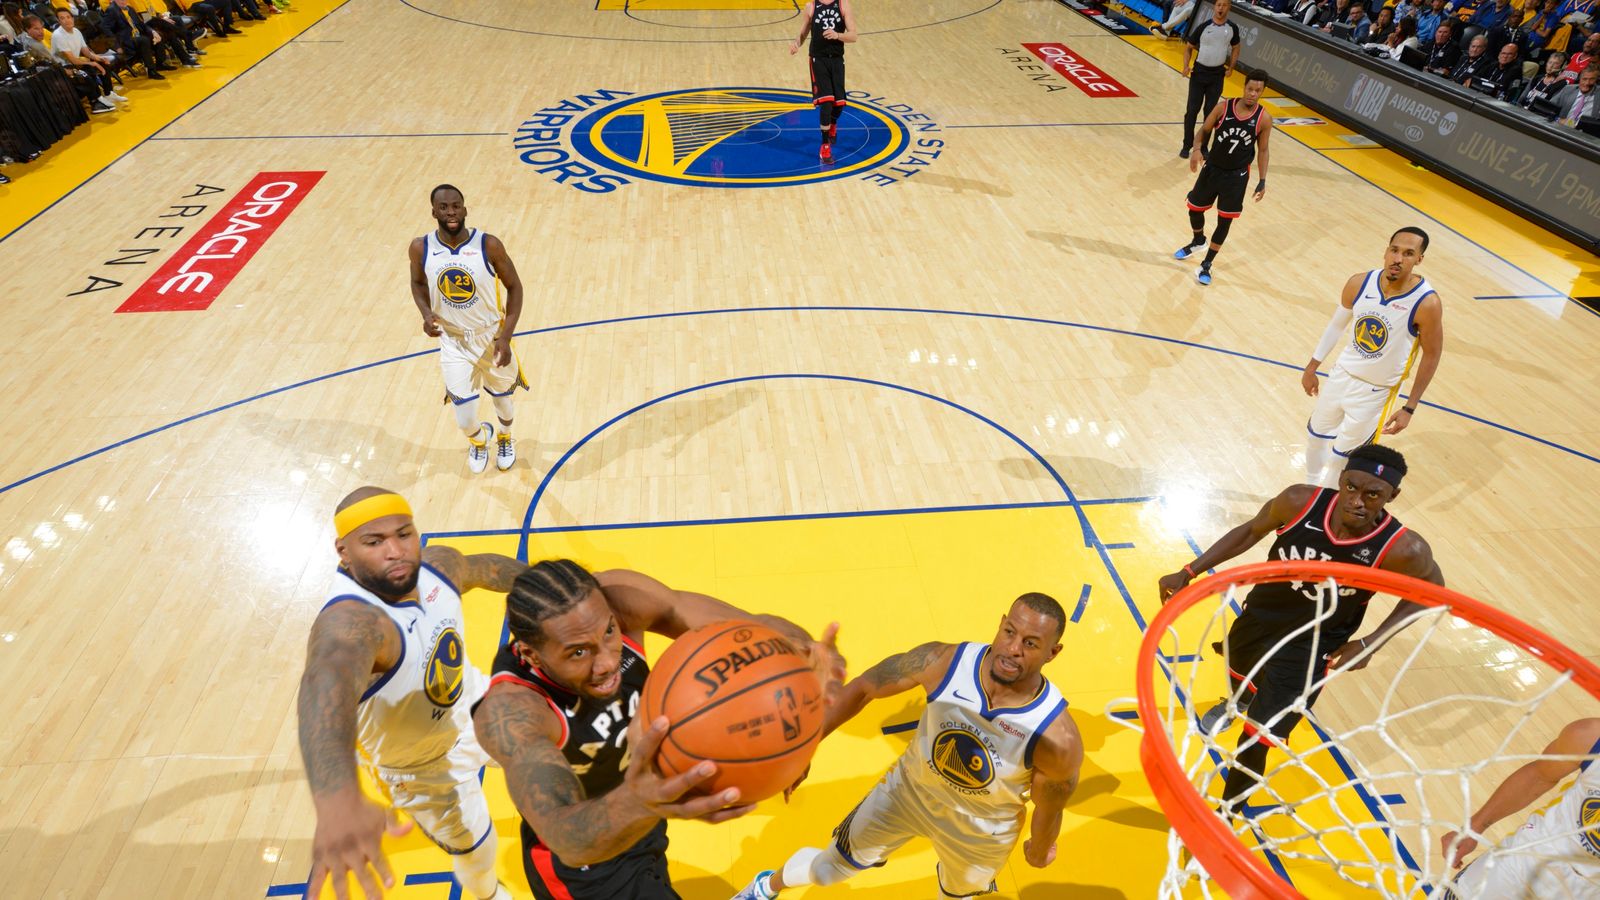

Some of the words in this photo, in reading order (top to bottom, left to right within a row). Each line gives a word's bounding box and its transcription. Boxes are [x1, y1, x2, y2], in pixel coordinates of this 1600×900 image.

[822, 17, 836, 30] 33
[996, 47, 1067, 93] ARENA
[1038, 46, 1120, 92] ORACLE
[1256, 40, 1290, 69] JUNE
[1285, 52, 1307, 77] 24
[846, 90, 942, 133] OLDEN
[1353, 77, 1392, 122] NBA
[1388, 92, 1441, 125] AWARDS
[512, 88, 639, 194] WARRIORS
[1217, 127, 1253, 146] RAPTORS
[1228, 139, 1240, 154] 7
[860, 138, 945, 187] STATE
[1457, 131, 1518, 174] JUNE
[1510, 154, 1549, 188] 24
[66, 183, 226, 297] ARENA
[156, 181, 298, 295] ORACLE
[454, 275, 471, 286] 23
[441, 296, 479, 310] WARRIORS
[1369, 324, 1384, 339] 34
[421, 624, 441, 670] GOLDEN
[448, 640, 457, 661] 0
[693, 637, 797, 699] SPALDIN
[939, 720, 982, 737] GOLDEN
[982, 736, 1003, 768] STATE
[998, 720, 1026, 741] Rakuten
[968, 755, 984, 772] 9
